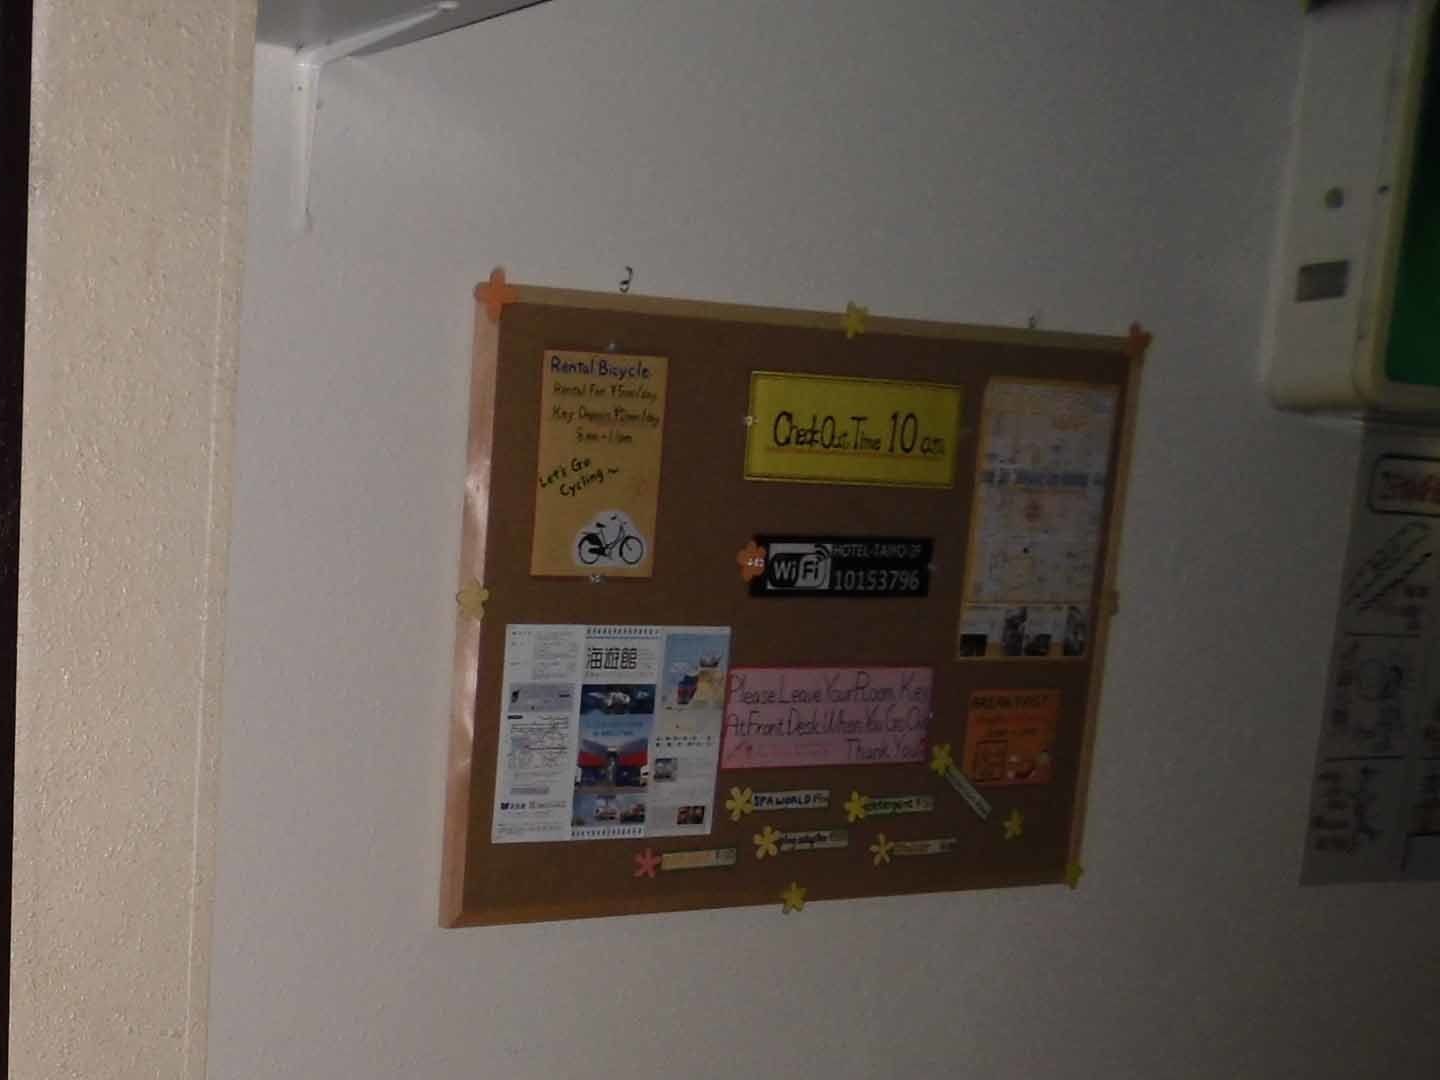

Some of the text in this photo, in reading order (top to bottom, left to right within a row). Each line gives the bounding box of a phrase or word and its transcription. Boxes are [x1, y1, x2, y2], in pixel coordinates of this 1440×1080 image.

[550, 355, 650, 380] Rental Bicycle
[888, 411, 919, 453] 10
[571, 458, 590, 472] Go
[833, 569, 921, 591] 10153796
